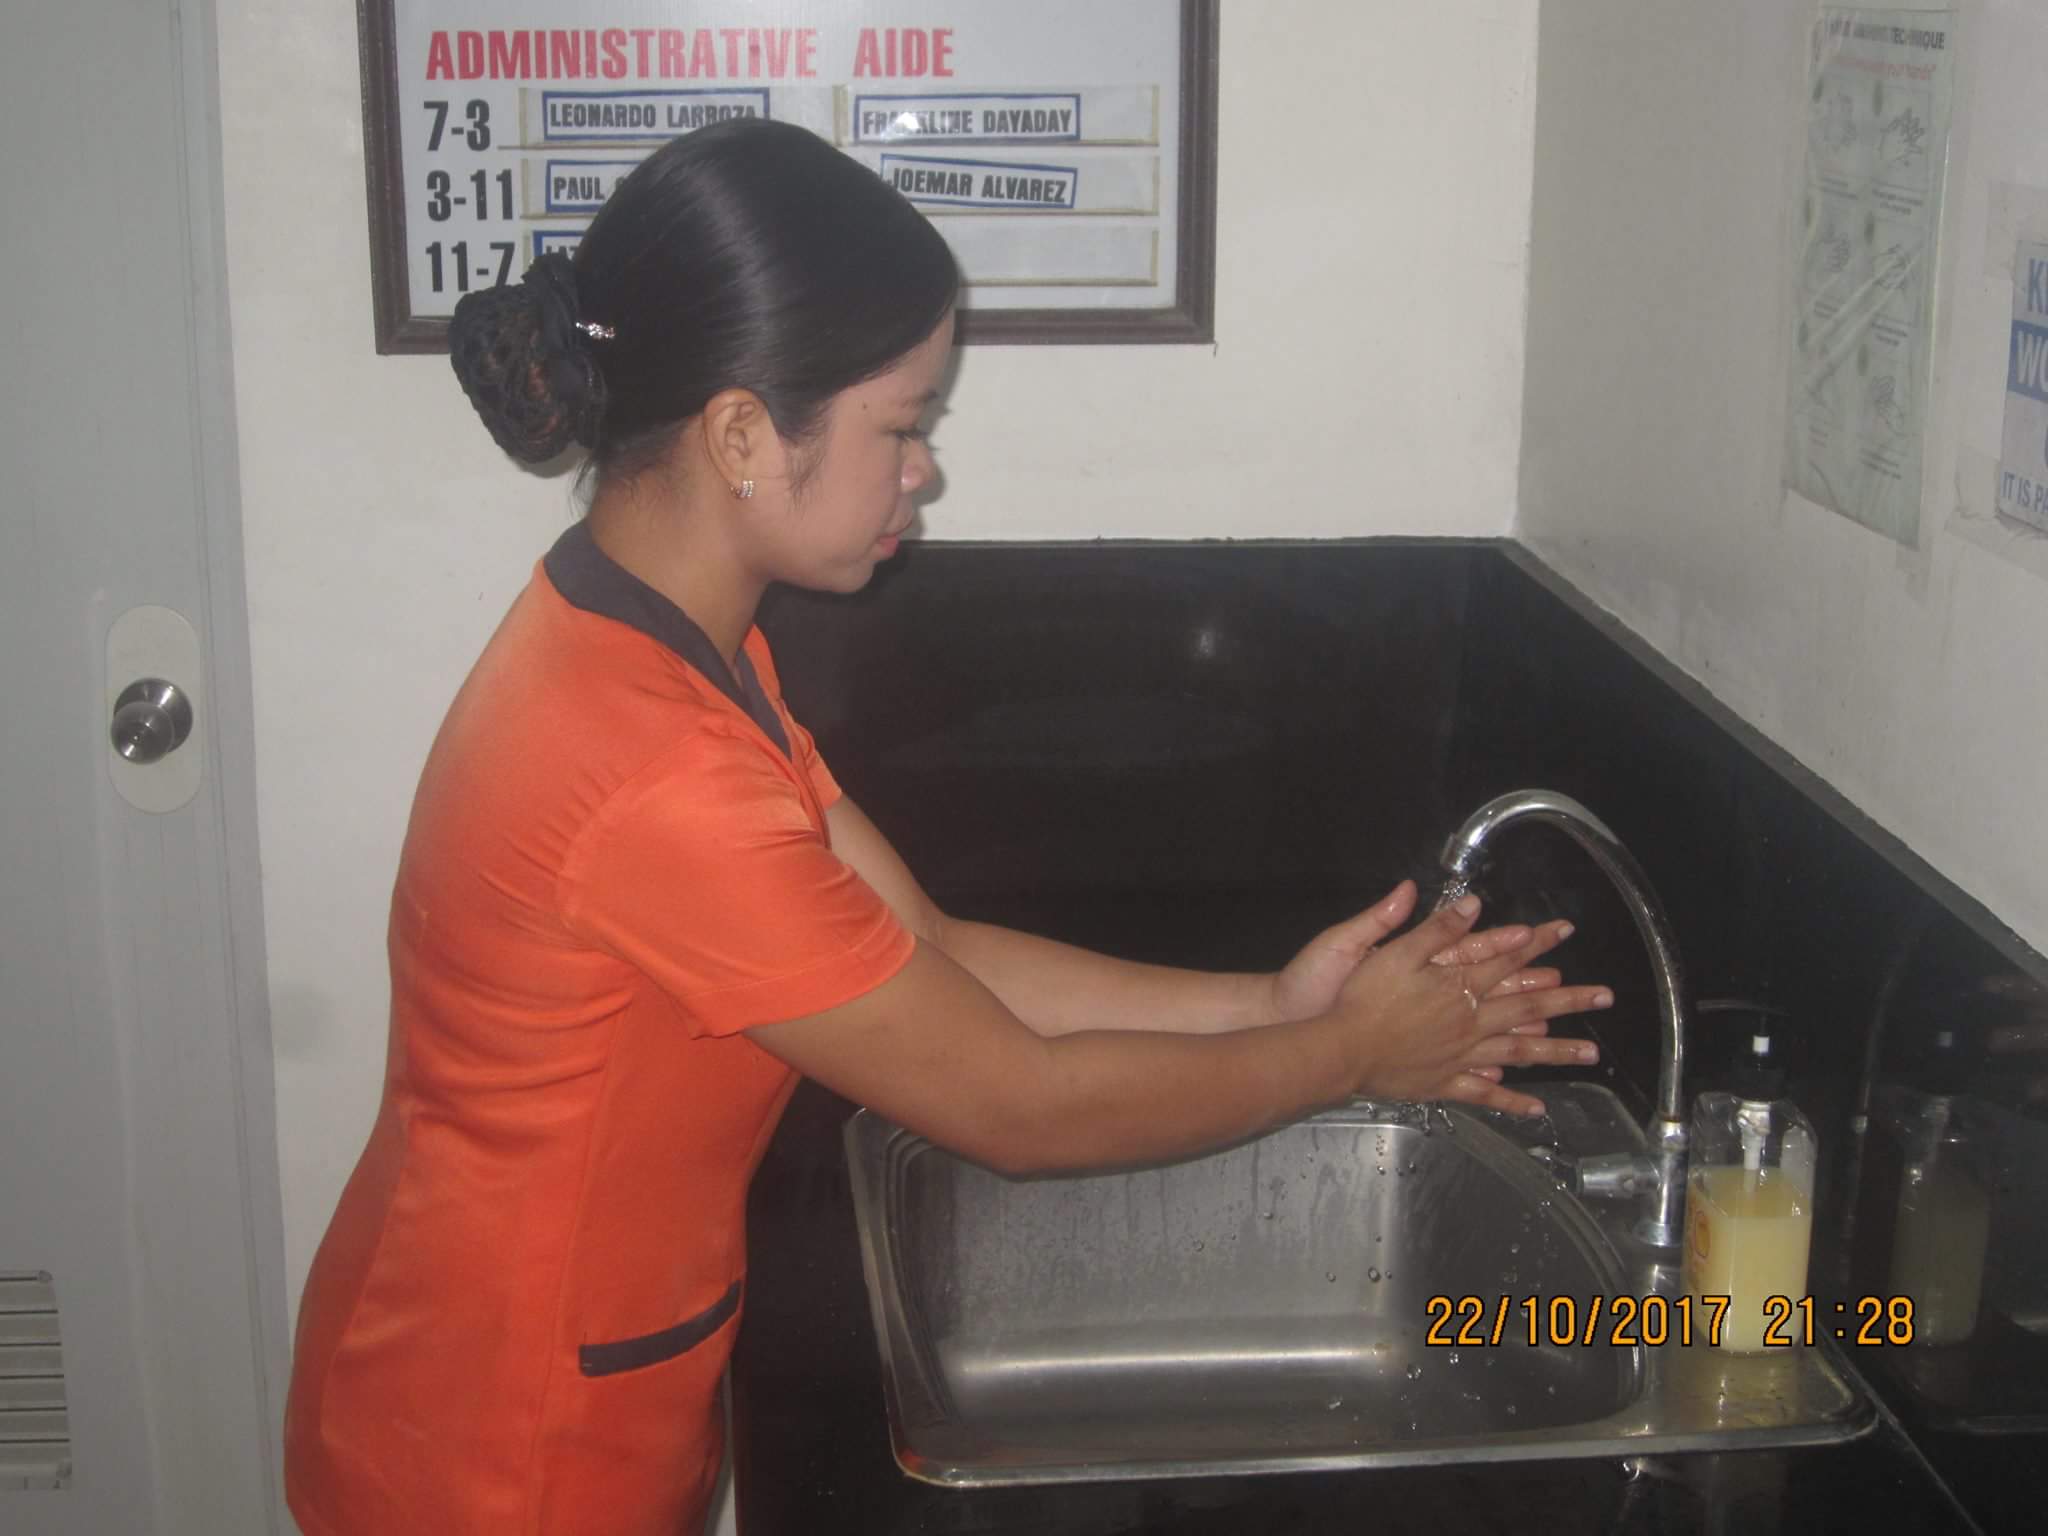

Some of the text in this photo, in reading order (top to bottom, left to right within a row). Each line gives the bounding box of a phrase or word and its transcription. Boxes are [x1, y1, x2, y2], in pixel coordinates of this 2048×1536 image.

[426, 28, 955, 81] ADMINISTRATIVE AIDE
[424, 99, 491, 151] 7-3
[551, 103, 657, 128] LEONARDO
[863, 109, 1073, 135] FRKLINE DAYADAY
[427, 169, 514, 221] 3-11
[553, 176, 606, 201] PAUL
[889, 167, 1068, 204] JOEMAR ALVAREZ
[426, 241, 515, 292] 11-7
